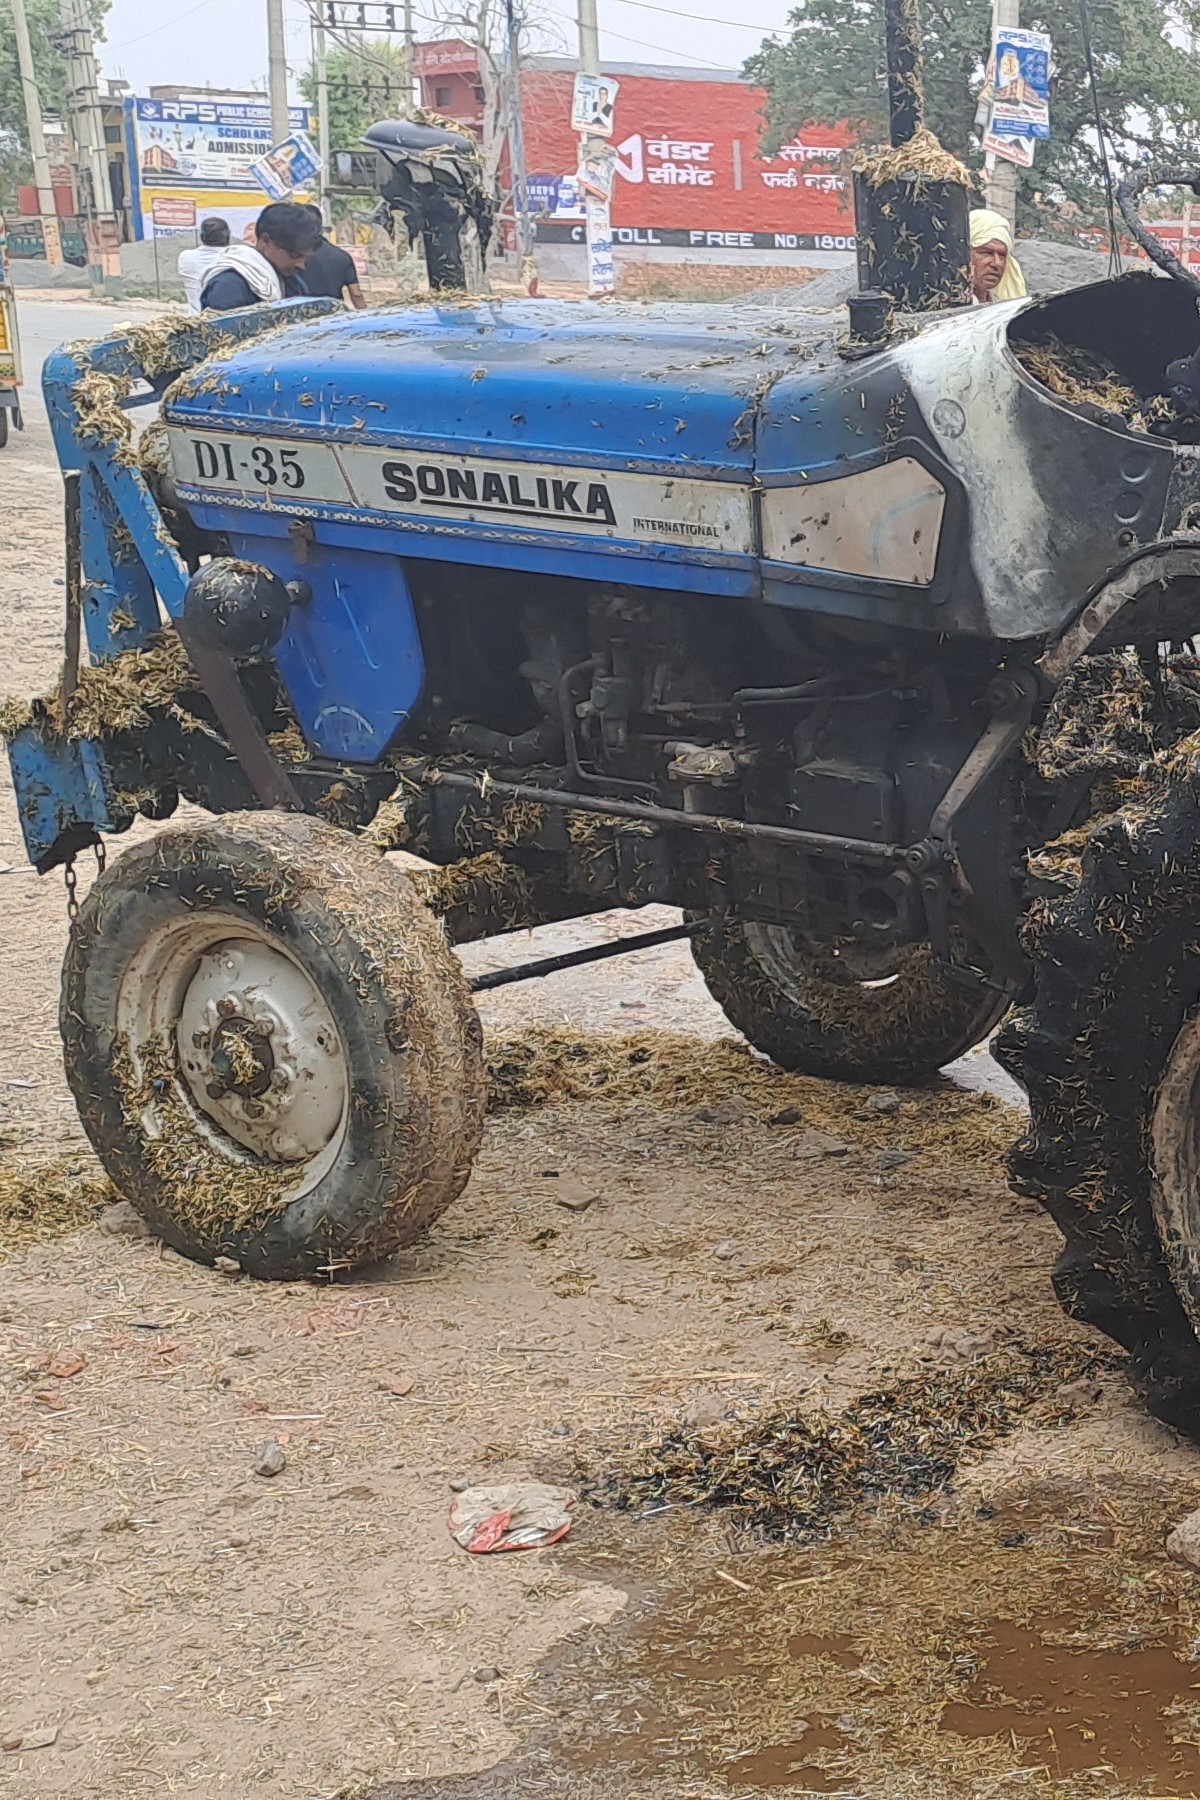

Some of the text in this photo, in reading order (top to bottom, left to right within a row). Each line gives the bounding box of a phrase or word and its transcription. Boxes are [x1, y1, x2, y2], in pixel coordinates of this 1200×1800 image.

[162, 102, 216, 122] RPS
[217, 127, 273, 139] SCHOLARS
[645, 134, 714, 161] वंडर
[647, 163, 715, 186] सीमेंट
[761, 167, 798, 188] फर्क
[689, 230, 755, 247] FREE
[190, 439, 305, 489] DI-35
[382, 461, 618, 527] SONALIKA
[633, 517, 720, 538] INTERNATIONAL
